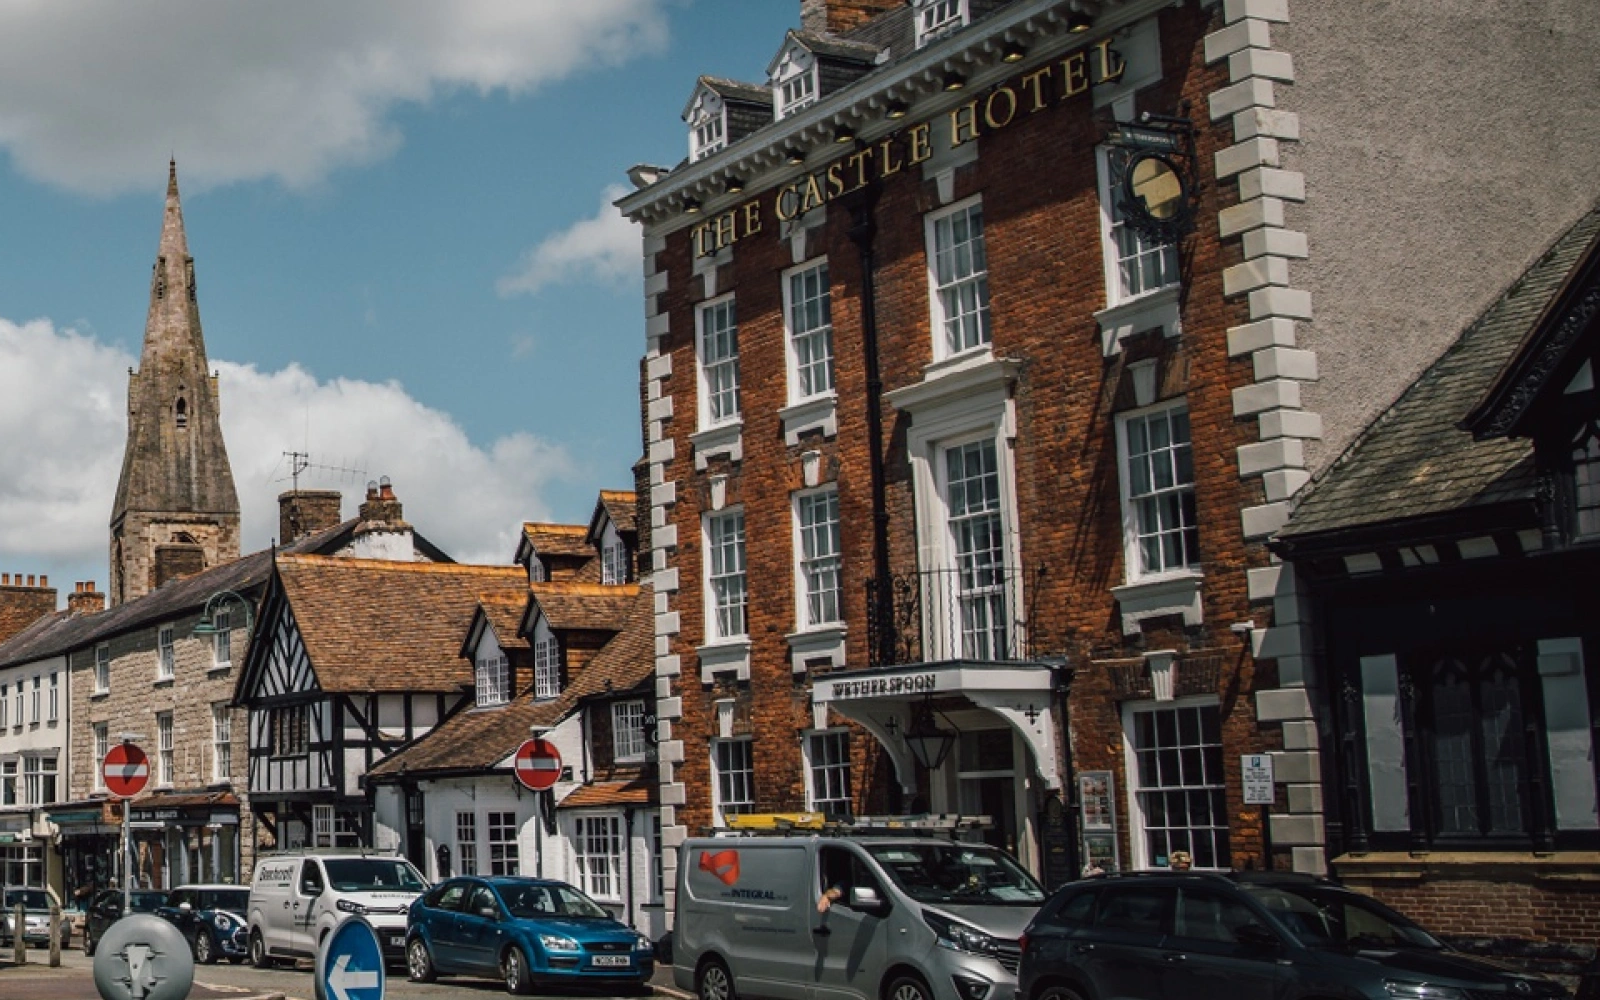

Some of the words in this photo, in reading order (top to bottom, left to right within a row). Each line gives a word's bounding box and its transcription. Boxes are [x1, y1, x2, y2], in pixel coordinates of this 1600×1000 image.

[690, 200, 763, 259] THE
[775, 121, 932, 223] CASTLE
[948, 37, 1127, 149] HOTEL
[832, 674, 936, 697] WETHERSPOON
